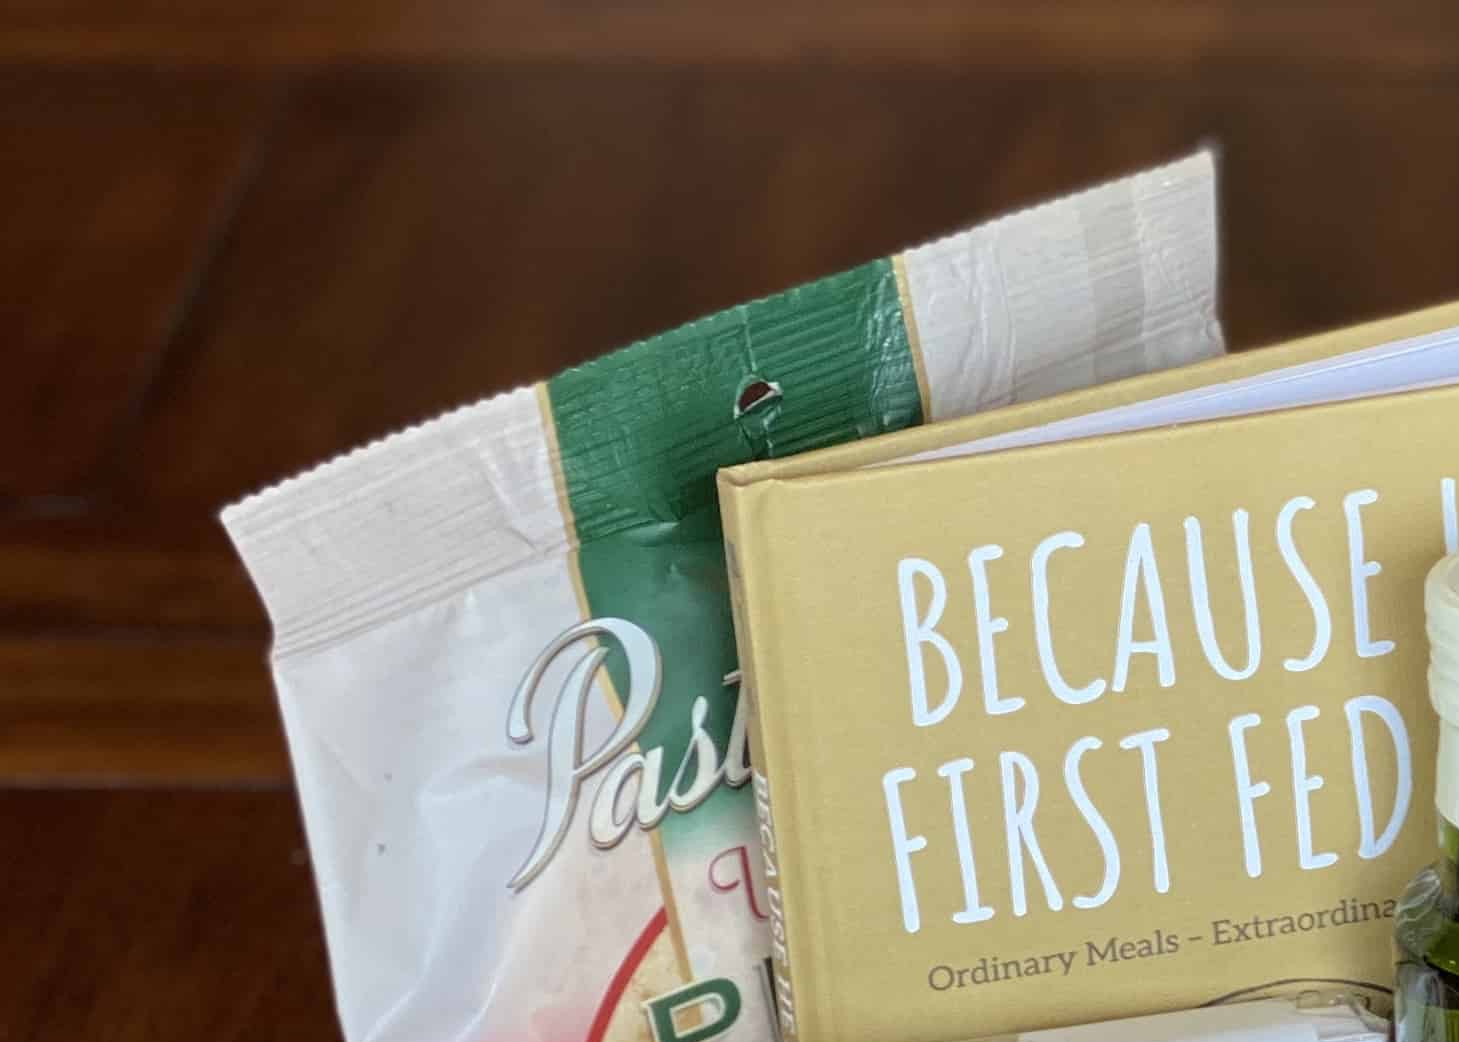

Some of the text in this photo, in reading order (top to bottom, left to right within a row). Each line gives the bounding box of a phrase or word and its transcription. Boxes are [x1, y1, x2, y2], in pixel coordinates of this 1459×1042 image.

[897, 488, 1396, 728] BECAUSE
[507, 616, 753, 893] Past
[882, 727, 1172, 933] FIRST
[1228, 694, 1413, 879] FED
[927, 947, 1077, 992] Ordinary
[1085, 929, 1180, 967] Meals
[1211, 897, 1397, 946] Extraordina
